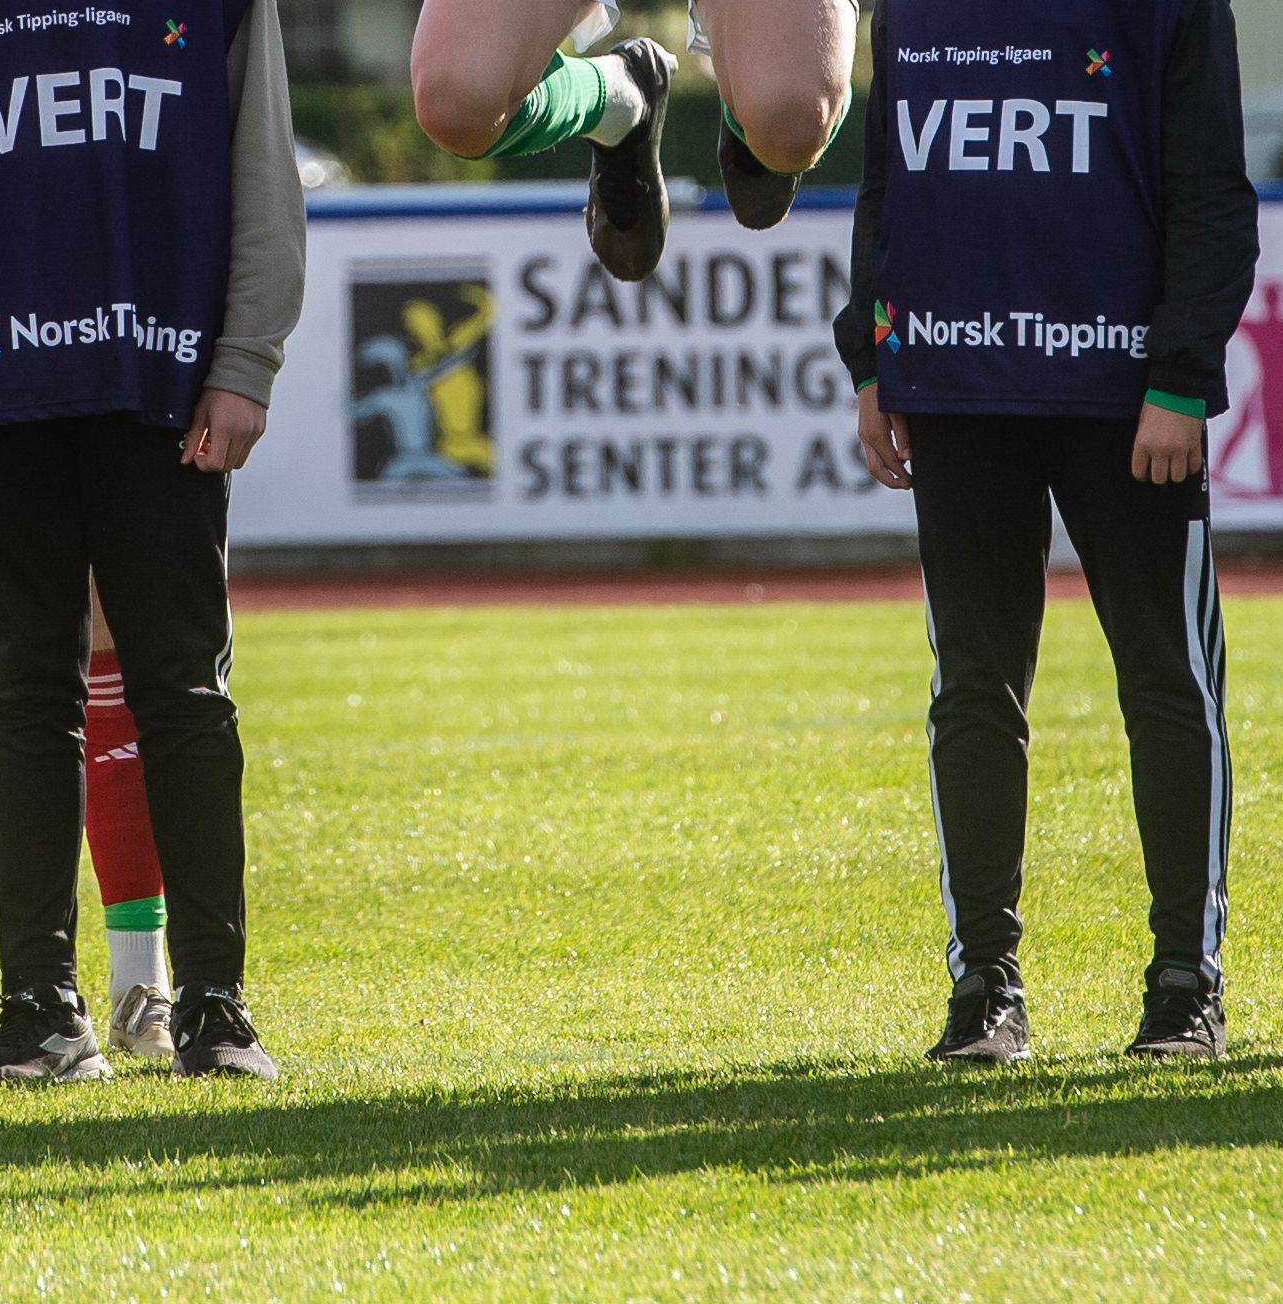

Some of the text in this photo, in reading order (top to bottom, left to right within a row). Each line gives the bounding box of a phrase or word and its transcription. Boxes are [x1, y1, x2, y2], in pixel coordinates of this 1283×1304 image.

[16, 7, 131, 31] Tipping-ligaen
[898, 46, 1052, 65] Norsk Tipping-ligaen
[897, 98, 1108, 173] VERT
[10, 306, 111, 350] Norsk
[908, 311, 1151, 359] Norsk Tipping
[521, 351, 858, 415] TRENING
[519, 438, 769, 498] SENTER
